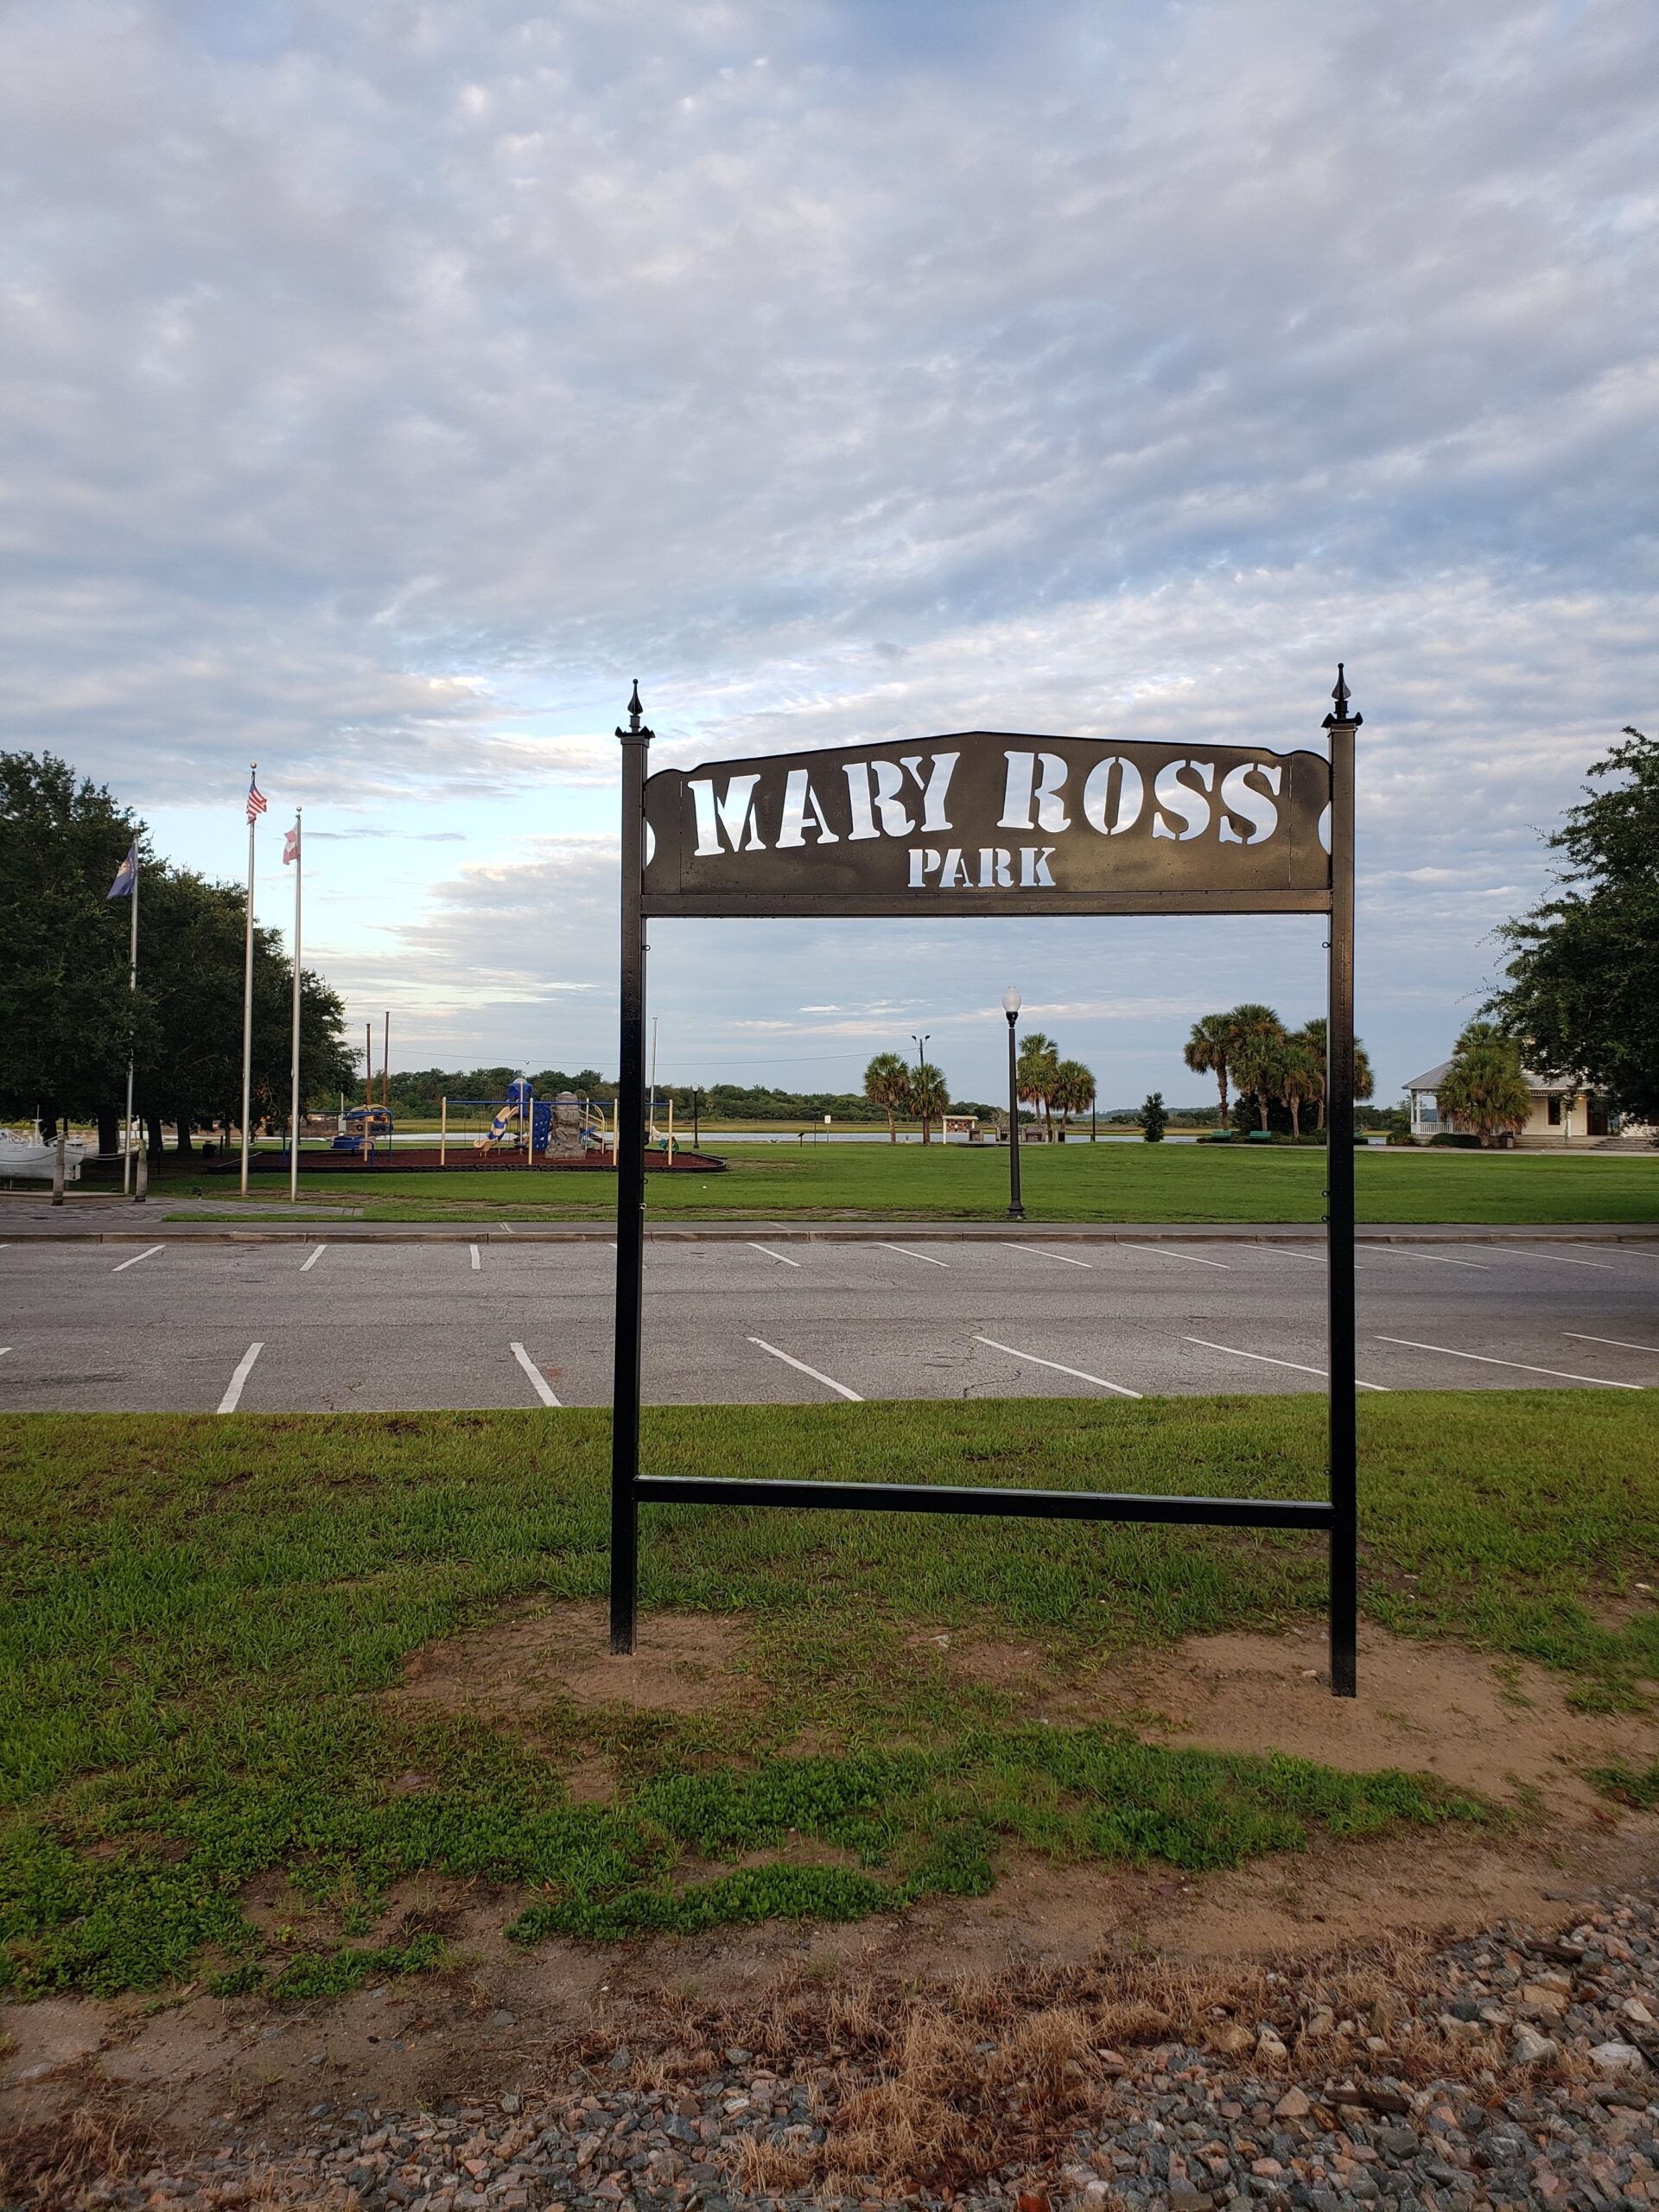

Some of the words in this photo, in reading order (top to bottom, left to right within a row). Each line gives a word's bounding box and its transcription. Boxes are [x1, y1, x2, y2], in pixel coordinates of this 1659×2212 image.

[687, 751, 961, 857] MARY
[996, 750, 1282, 845] ROSS
[907, 847, 1057, 888] PARK
